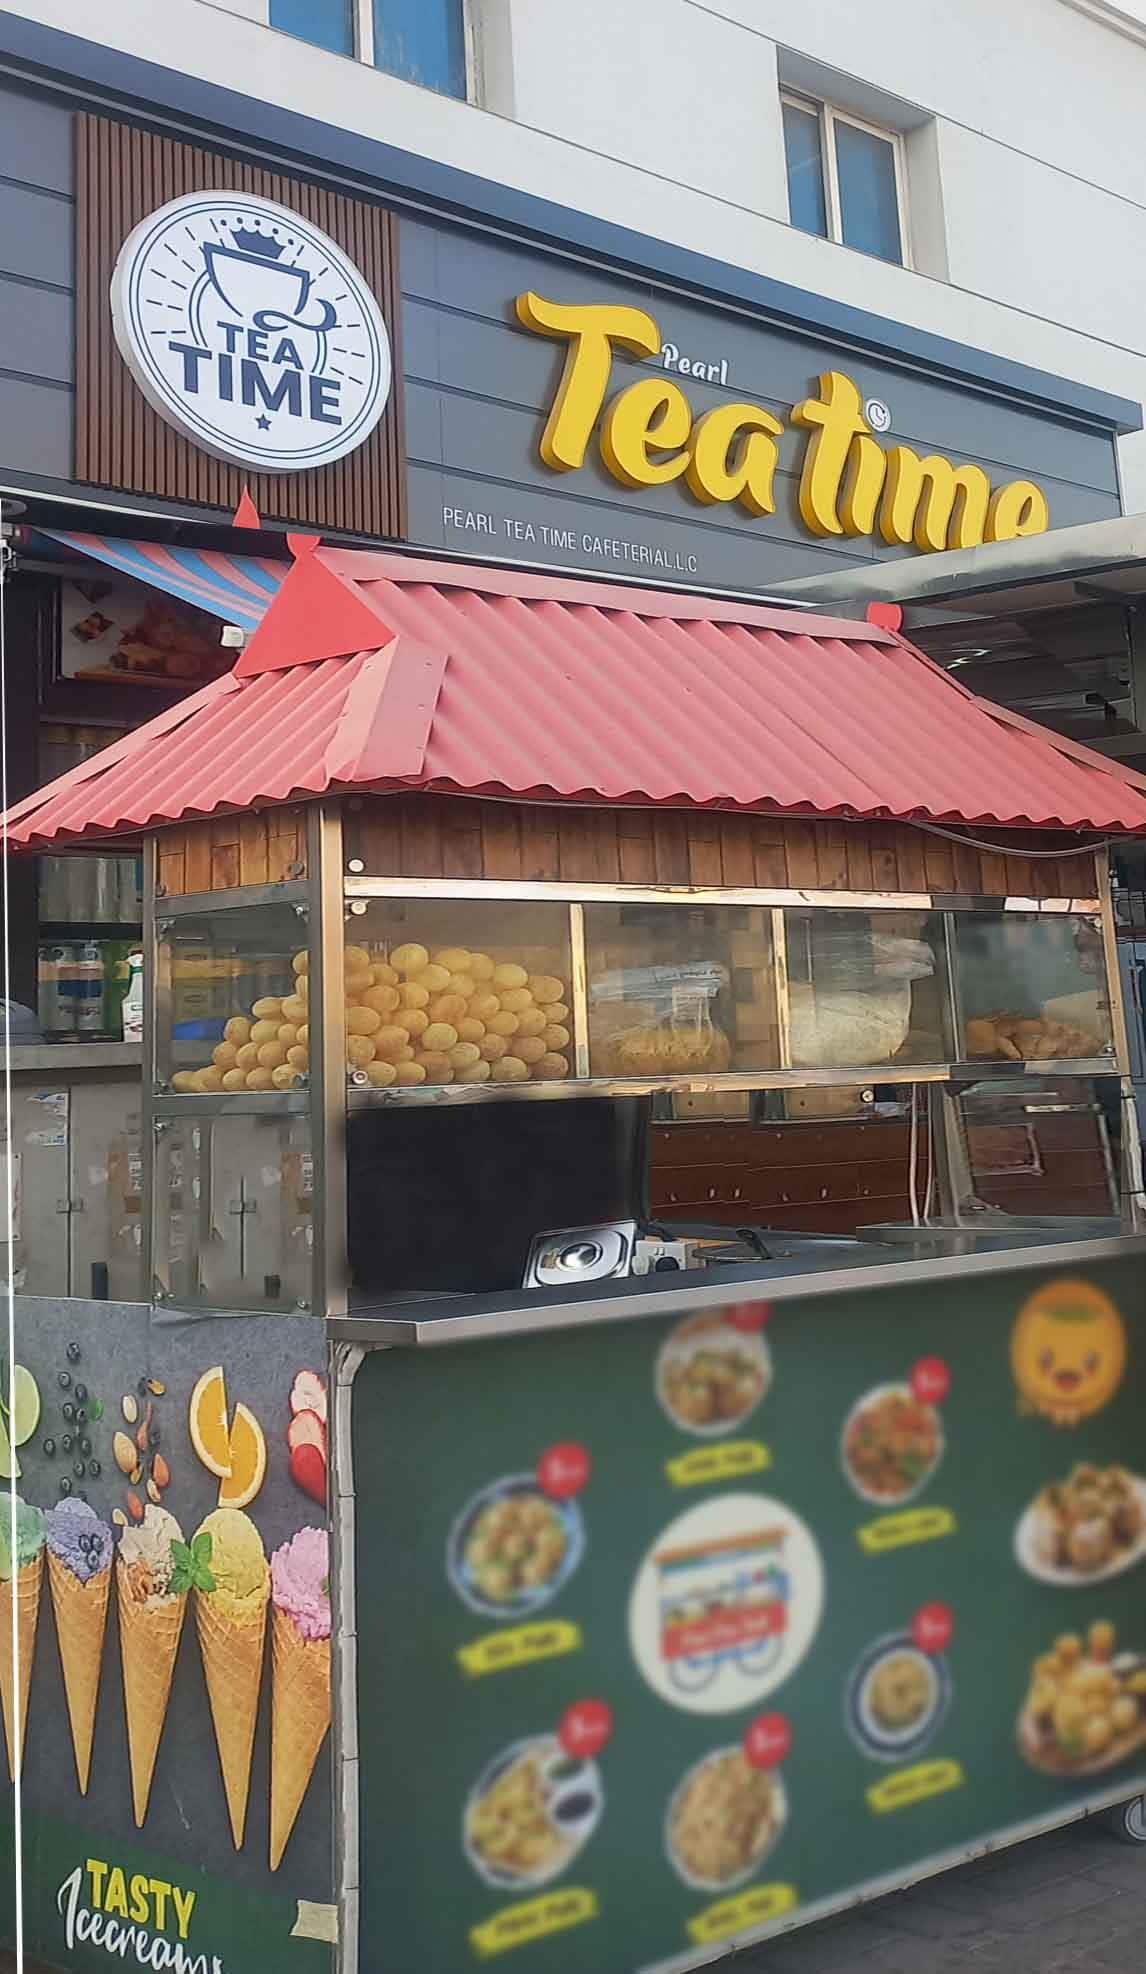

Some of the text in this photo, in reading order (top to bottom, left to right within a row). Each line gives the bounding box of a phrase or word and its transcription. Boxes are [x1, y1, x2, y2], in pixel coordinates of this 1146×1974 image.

[217, 321, 304, 370] TEA
[661, 343, 728, 385] Pearl
[169, 341, 342, 425] TIME
[515, 290, 785, 518] Tea
[442, 506, 497, 536] PEARL
[503, 518, 537, 543] TEA
[540, 526, 577, 550] TIME
[86, 1858, 196, 1939] TASTY
